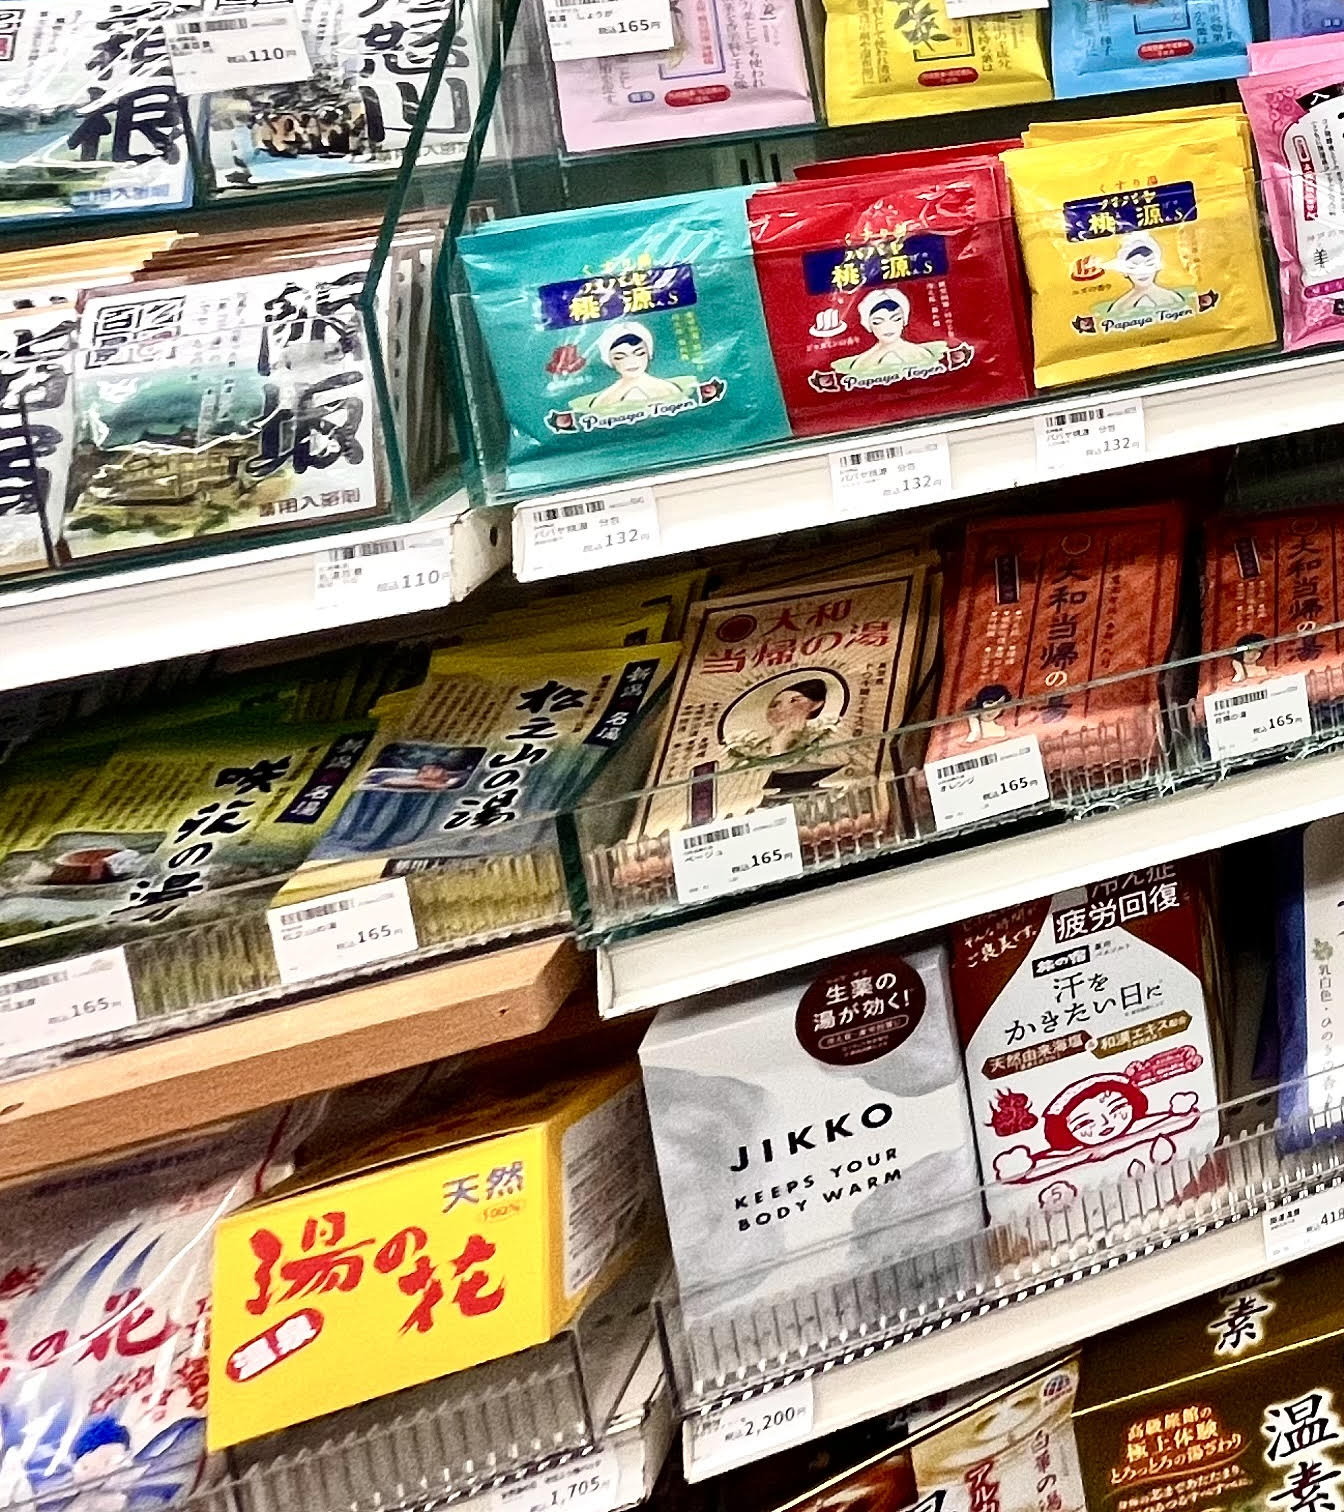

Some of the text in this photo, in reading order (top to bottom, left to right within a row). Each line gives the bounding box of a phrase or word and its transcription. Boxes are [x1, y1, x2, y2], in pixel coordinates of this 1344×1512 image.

[597, 18, 662, 35] 税込165円
[1099, 176, 1159, 194] くすり湯
[1088, 206, 1164, 235] 桃源
[1101, 307, 1193, 333] Papaya Togen
[843, 362, 946, 391] Papaya Togen
[581, 397, 697, 432] Papaya Togen
[762, 598, 853, 636] 大和
[701, 620, 891, 675] 当帰の湯
[1033, 562, 1090, 724] 大和当帰の湯
[1252, 713, 1303, 735] 税込165円
[442, 679, 588, 833] 松之山の湯
[982, 777, 1038, 802] 税込165円
[731, 848, 794, 874] 税込165円
[1055, 882, 1182, 943] 疲労回復
[825, 973, 897, 1005] 生薬の
[1053, 973, 1111, 1004] 汗を
[812, 990, 911, 1033] 湯が効く!
[1004, 981, 1163, 1046] かきたい日に
[1100, 1016, 1189, 1051] 和漢エキス配合
[988, 1035, 1086, 1074] 天然由来海塩
[729, 1101, 895, 1173] JIKKO
[442, 1161, 524, 1215] 天然
[734, 1147, 900, 1210] KEEPS YOUR
[737, 1168, 903, 1232] BODY WARM
[244, 1210, 507, 1337] 湯の花
[1208, 1297, 1264, 1354] 素
[1124, 1419, 1221, 1462] 極上体験
[1125, 1403, 1214, 1443] 高級旅館の
[1108, 1432, 1245, 1487] とろっとろの湯ざわり
